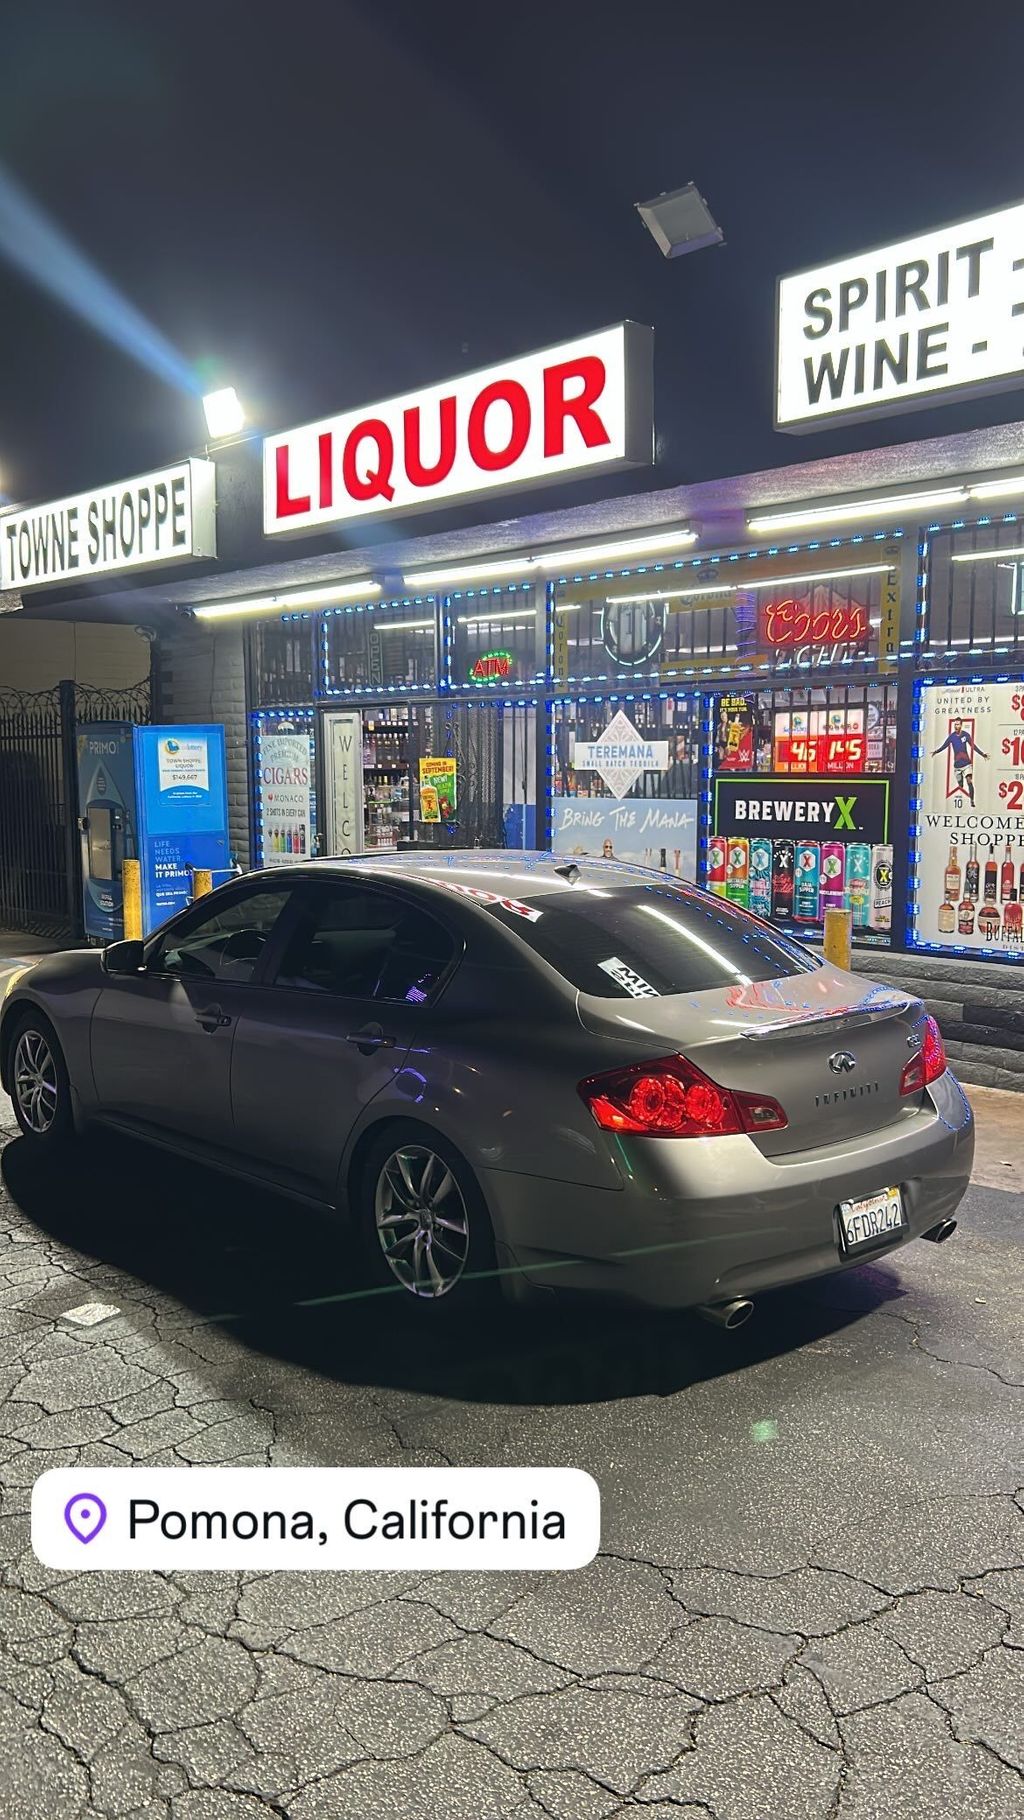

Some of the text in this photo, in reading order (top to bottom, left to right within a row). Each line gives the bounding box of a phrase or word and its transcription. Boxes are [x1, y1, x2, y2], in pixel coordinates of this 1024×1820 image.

[803, 237, 994, 340] SPIRIT
[803, 322, 949, 405] WINE
[276, 355, 611, 519] LIQUOR
[6, 476, 187, 581] TOWNE SHOPPE
[766, 600, 866, 642] Coors
[473, 658, 511, 678] ATM
[721, 698, 730, 706] BE
[89, 741, 117, 755] PRIMO
[587, 745, 653, 759] TEREMANA
[263, 767, 308, 785] CIGARS
[274, 794, 304, 803] MONACO
[609, 806, 636, 831] THE
[926, 815, 1024, 829] WELCOME
[154, 840, 170, 848] LIFE
[155, 848, 180, 856] NEEDS
[155, 863, 178, 871] MAKE
[814, 1081, 879, 1108] INFINITI
[847, 1203, 900, 1244] 6FDR242
